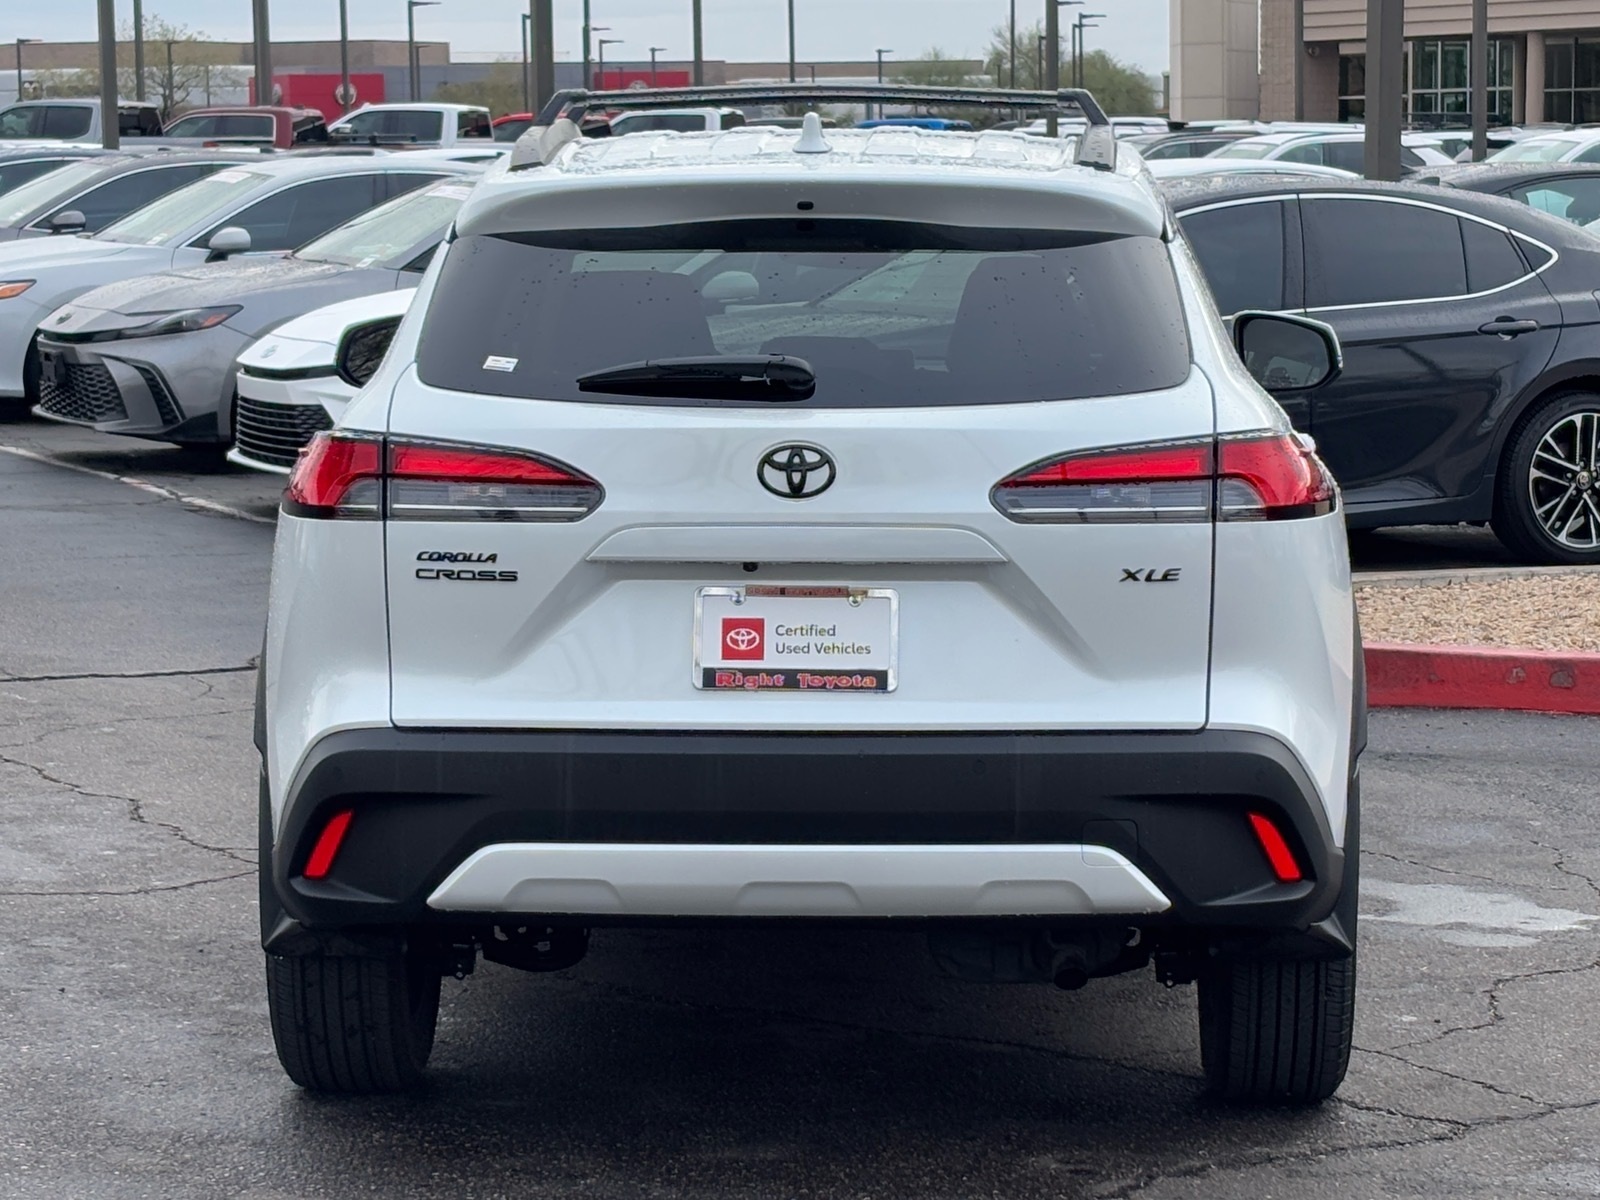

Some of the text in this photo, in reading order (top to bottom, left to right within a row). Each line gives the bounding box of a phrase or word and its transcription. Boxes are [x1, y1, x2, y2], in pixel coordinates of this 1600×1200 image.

[416, 551, 498, 563] COROLLA
[415, 568, 518, 582] CROSS
[1119, 568, 1182, 582] XLE
[775, 624, 836, 637] Certified
[775, 642, 871, 655] Used Vehicles
[715, 672, 877, 689] Right Toyota
